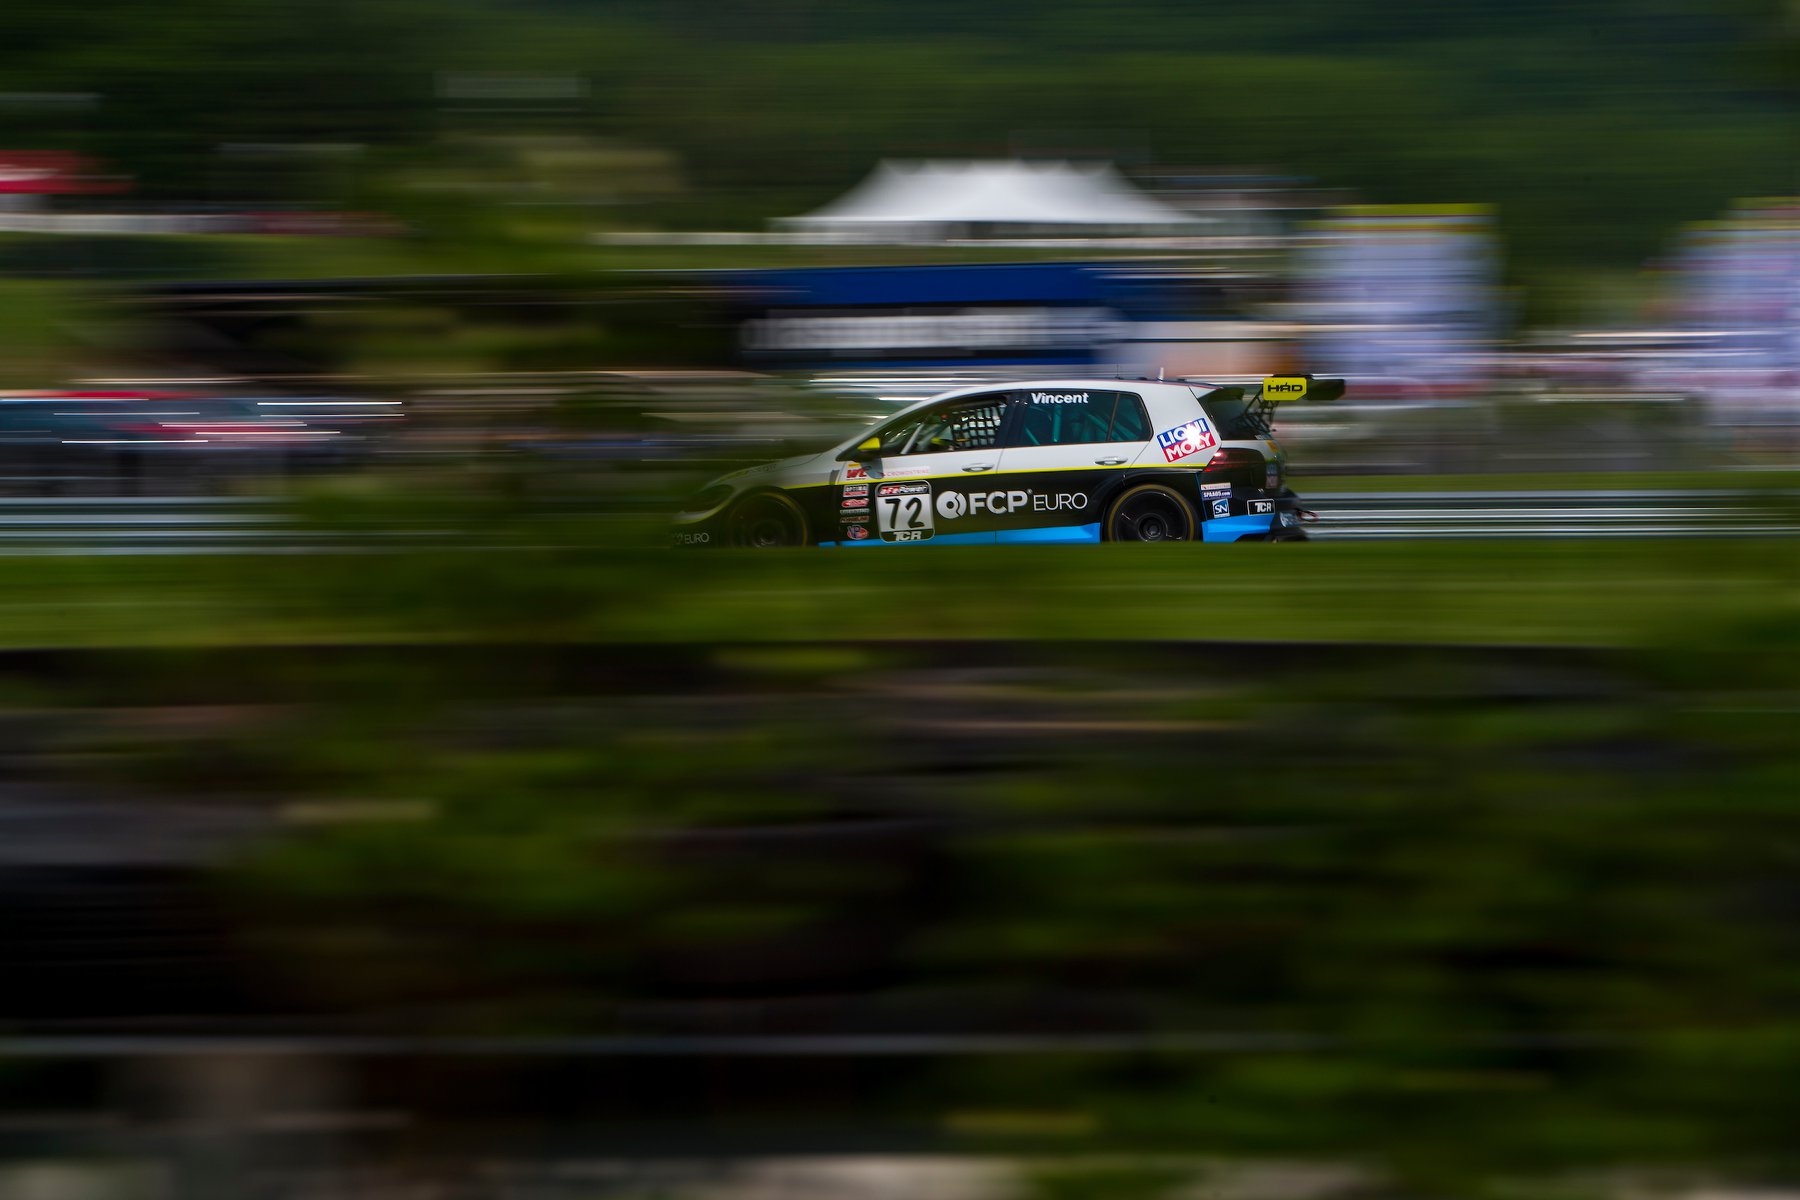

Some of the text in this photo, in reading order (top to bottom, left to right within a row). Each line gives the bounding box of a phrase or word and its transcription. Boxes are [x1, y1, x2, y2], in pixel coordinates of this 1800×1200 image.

[1031, 392, 1089, 404] Vincent
[1165, 432, 1211, 461] MOLY
[1033, 492, 1088, 511] EURO
[1255, 502, 1271, 513] TCR
[885, 497, 925, 530] 72
[684, 532, 710, 544] EURO
[893, 531, 922, 541] TCR
